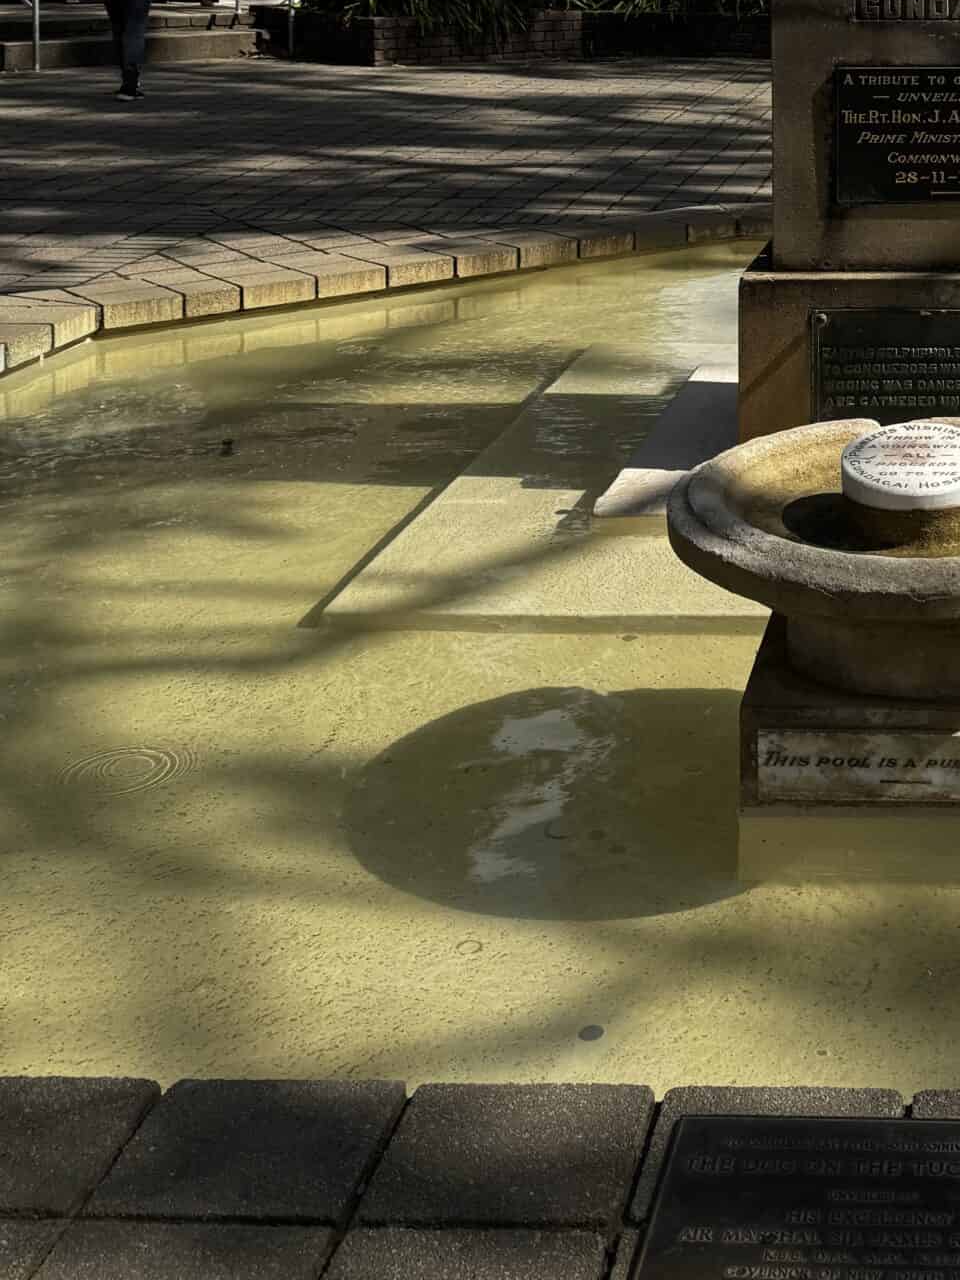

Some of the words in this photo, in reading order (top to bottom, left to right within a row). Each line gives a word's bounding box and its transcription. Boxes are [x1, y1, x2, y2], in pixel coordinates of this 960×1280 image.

[843, 73, 854, 86] A
[858, 75, 920, 86] TRIBUTE
[928, 75, 945, 86] TO
[857, 131, 907, 144] PRIME
[825, 396, 855, 408] ARE
[859, 396, 936, 408] GATHERED
[849, 459, 909, 489] GUNDAGAI
[764, 750, 810, 768] THIS
[815, 756, 870, 769] POOL
[878, 757, 898, 769] IS
[902, 757, 918, 769] A
[679, 1224, 714, 1242] AIR
